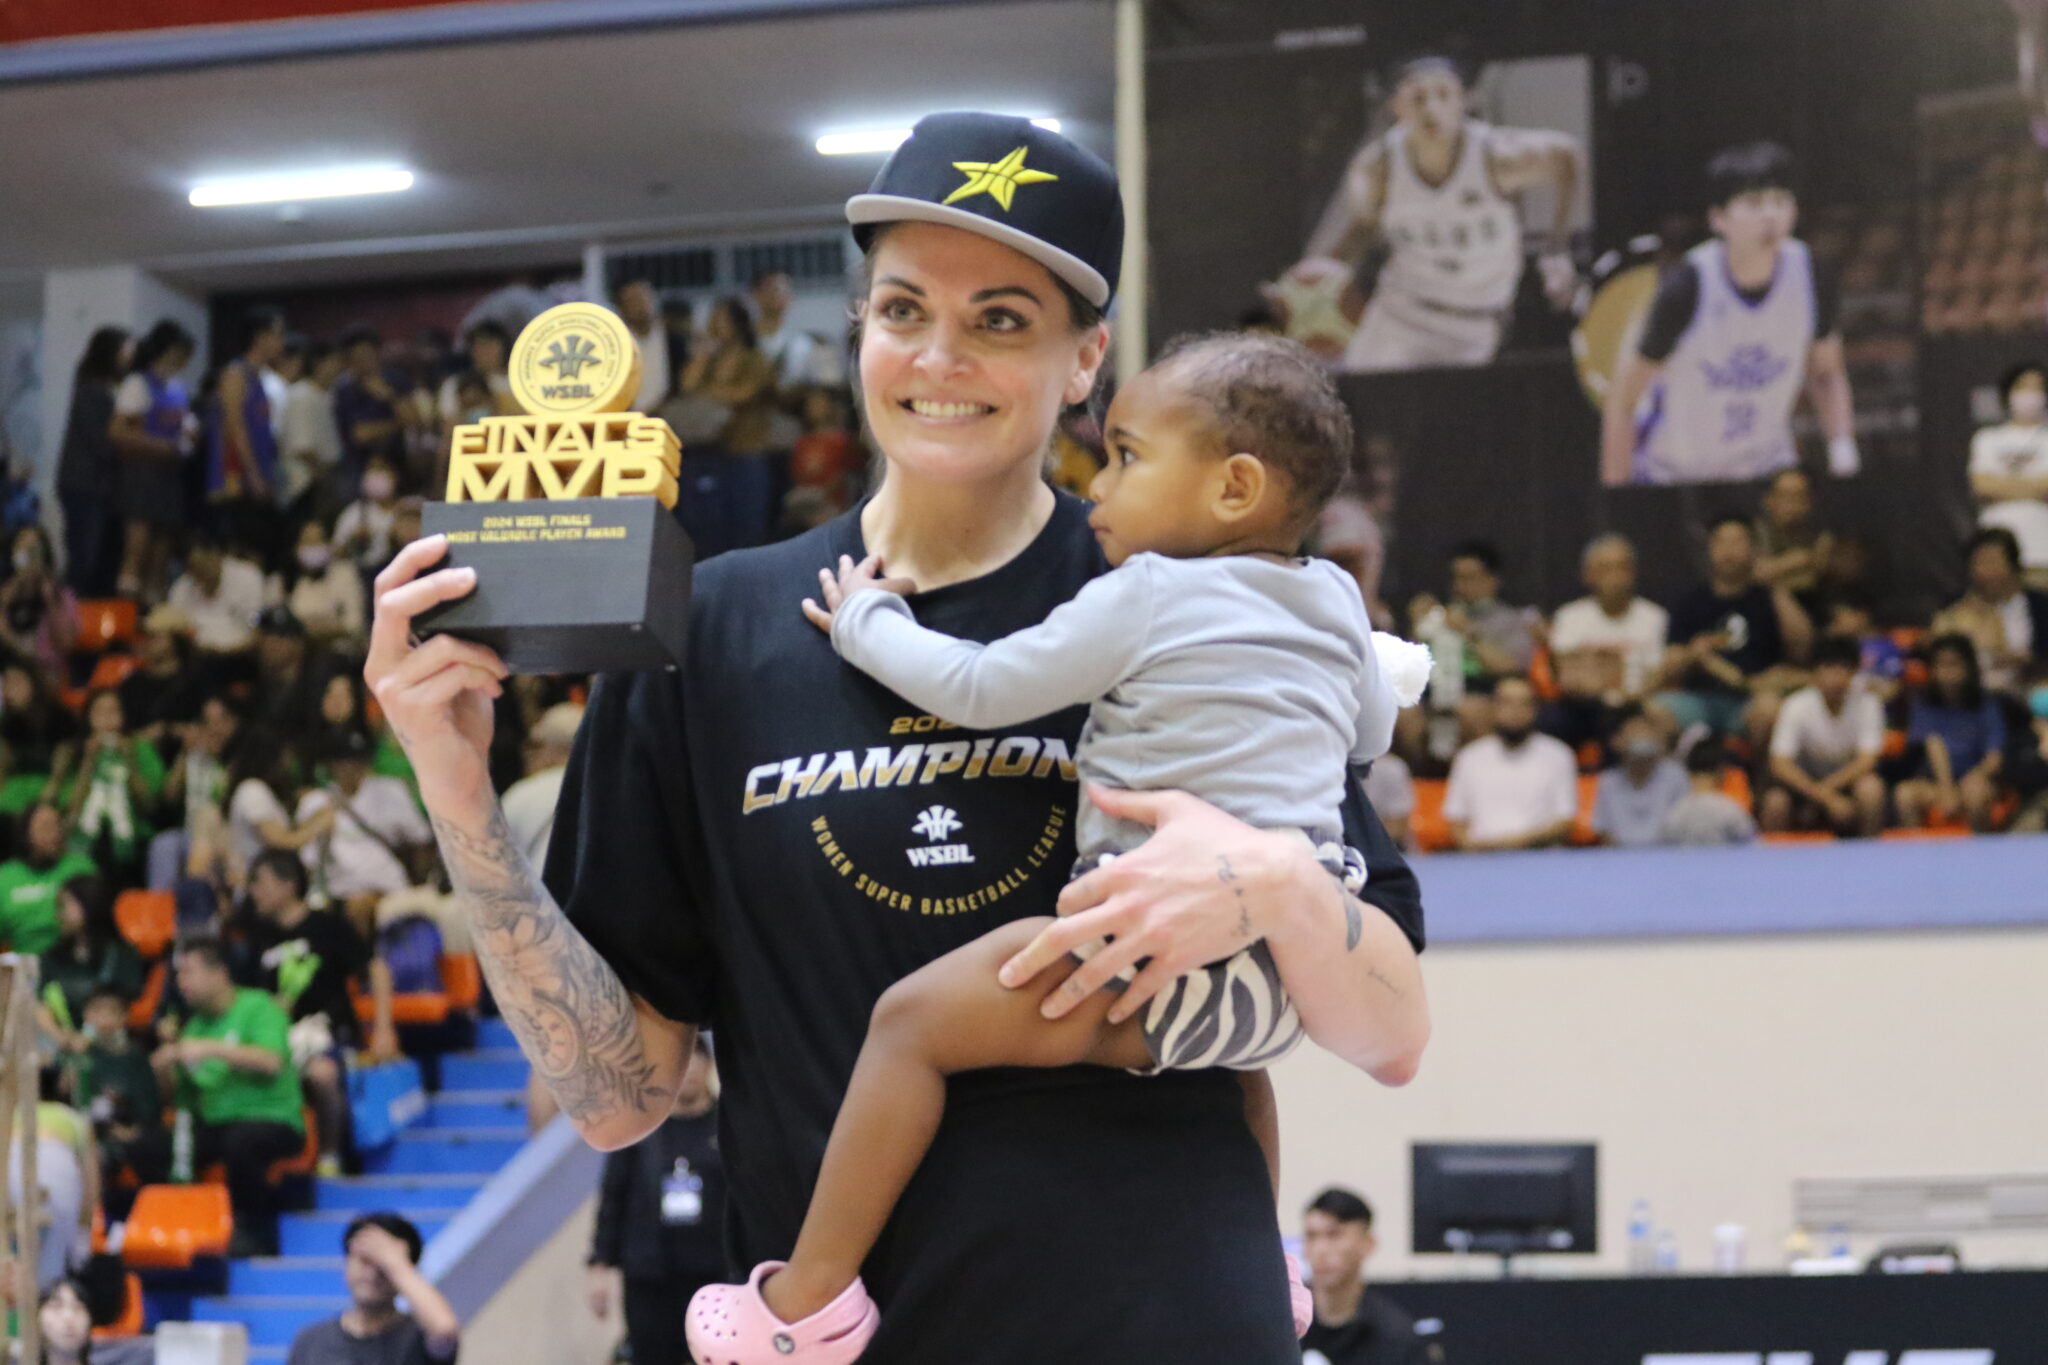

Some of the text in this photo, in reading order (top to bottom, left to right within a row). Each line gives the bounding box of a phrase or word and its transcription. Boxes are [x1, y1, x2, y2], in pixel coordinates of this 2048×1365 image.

[541, 384, 595, 399] WSBL
[451, 414, 668, 456] FINALS
[446, 453, 665, 503] MVP
[550, 514, 592, 526] FINALS
[811, 804, 1067, 915] WOMEN SUPER BASKETBALL LEAGUE
[906, 844, 975, 867] WSBL
